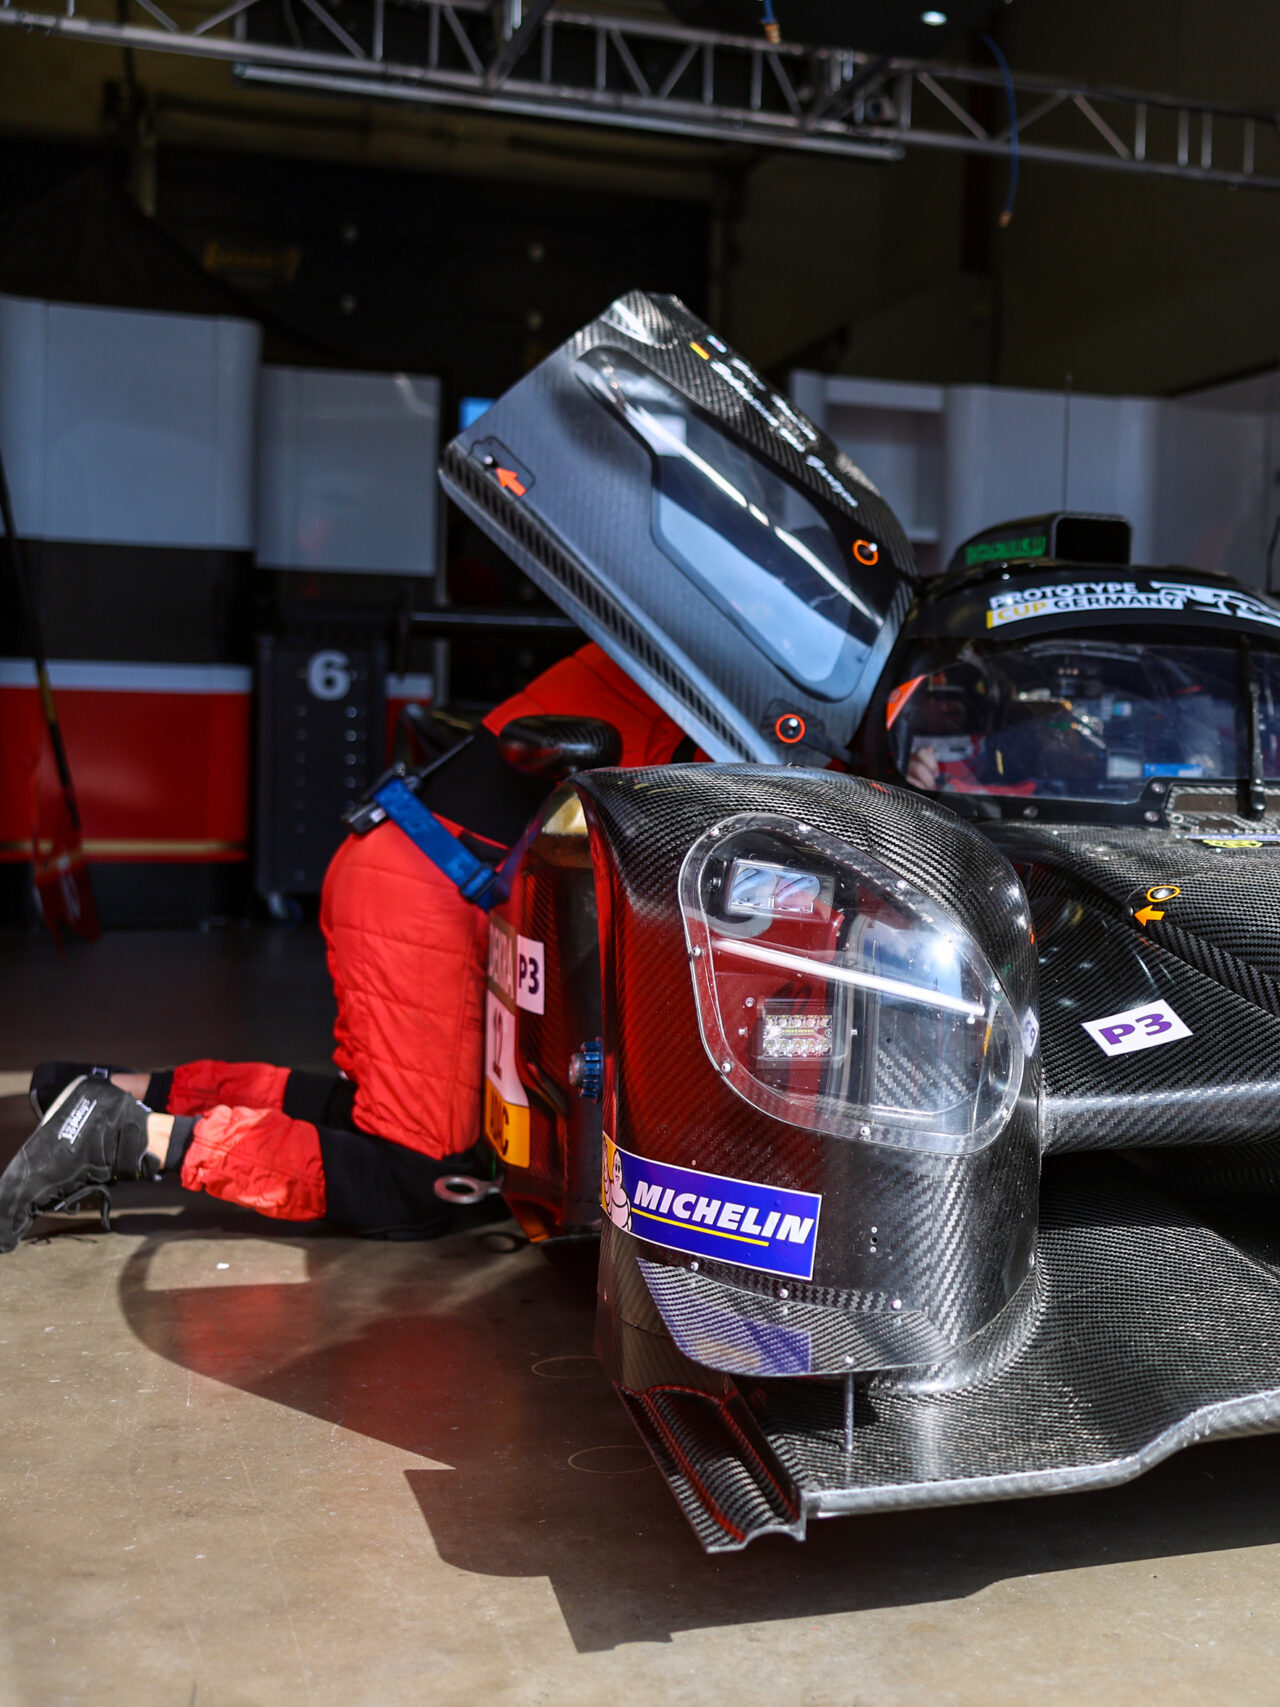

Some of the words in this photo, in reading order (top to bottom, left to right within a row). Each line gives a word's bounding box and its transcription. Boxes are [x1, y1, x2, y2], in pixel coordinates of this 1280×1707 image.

[990, 582, 1138, 609] PROTOTYPE
[997, 601, 1048, 623] CUP
[1054, 592, 1187, 610] GERMANY
[307, 650, 351, 701] 6
[518, 953, 540, 996] P3
[1098, 1013, 1173, 1046] P3
[634, 1181, 814, 1244] MICHELIN
